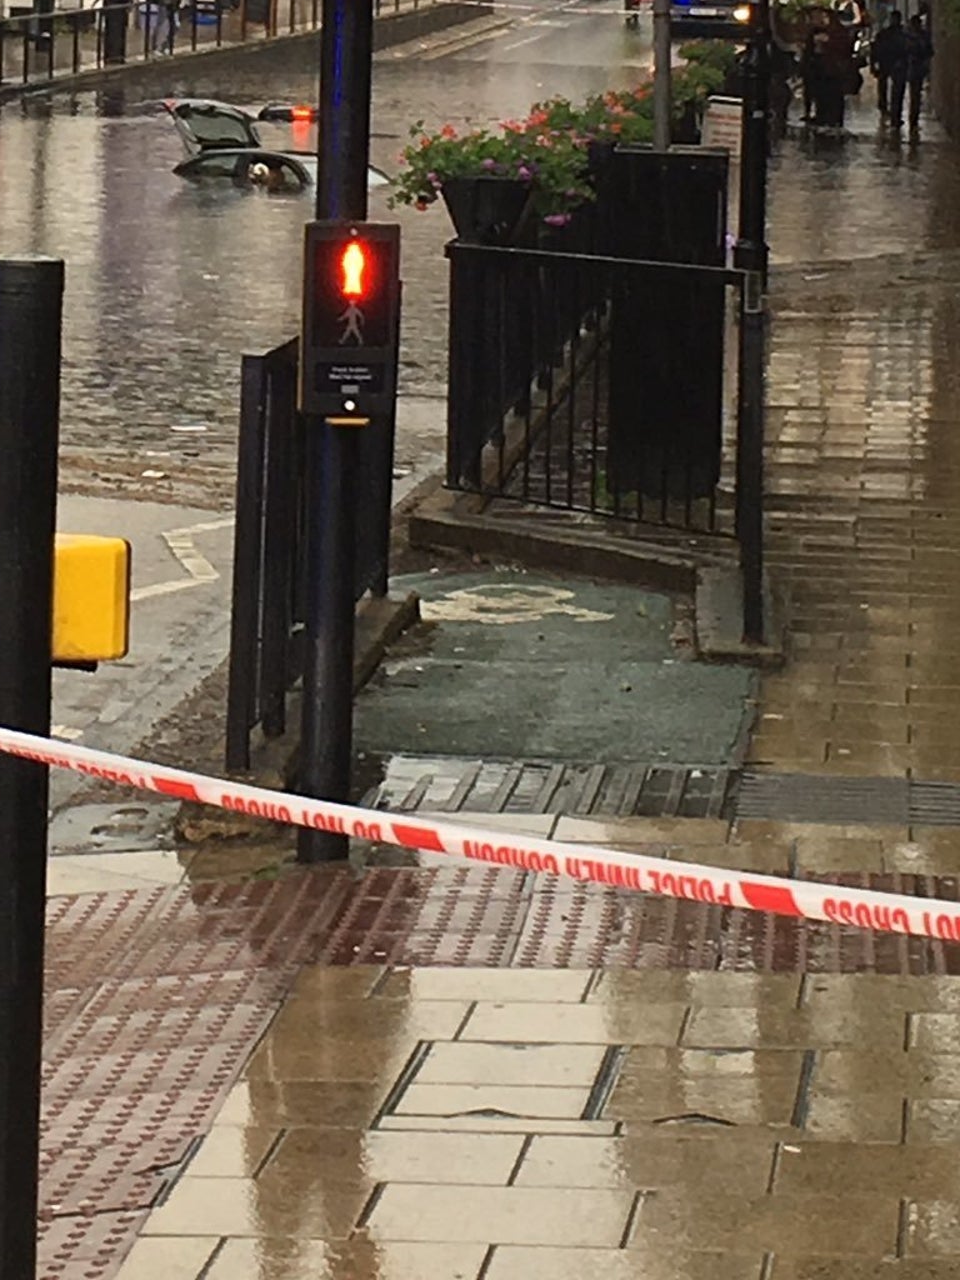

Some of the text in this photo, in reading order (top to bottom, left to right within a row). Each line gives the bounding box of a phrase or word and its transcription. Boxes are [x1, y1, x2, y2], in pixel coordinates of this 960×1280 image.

[565, 857, 640, 891] INNER
[648, 871, 734, 907] POLICE
[822, 898, 911, 936] CROSS
